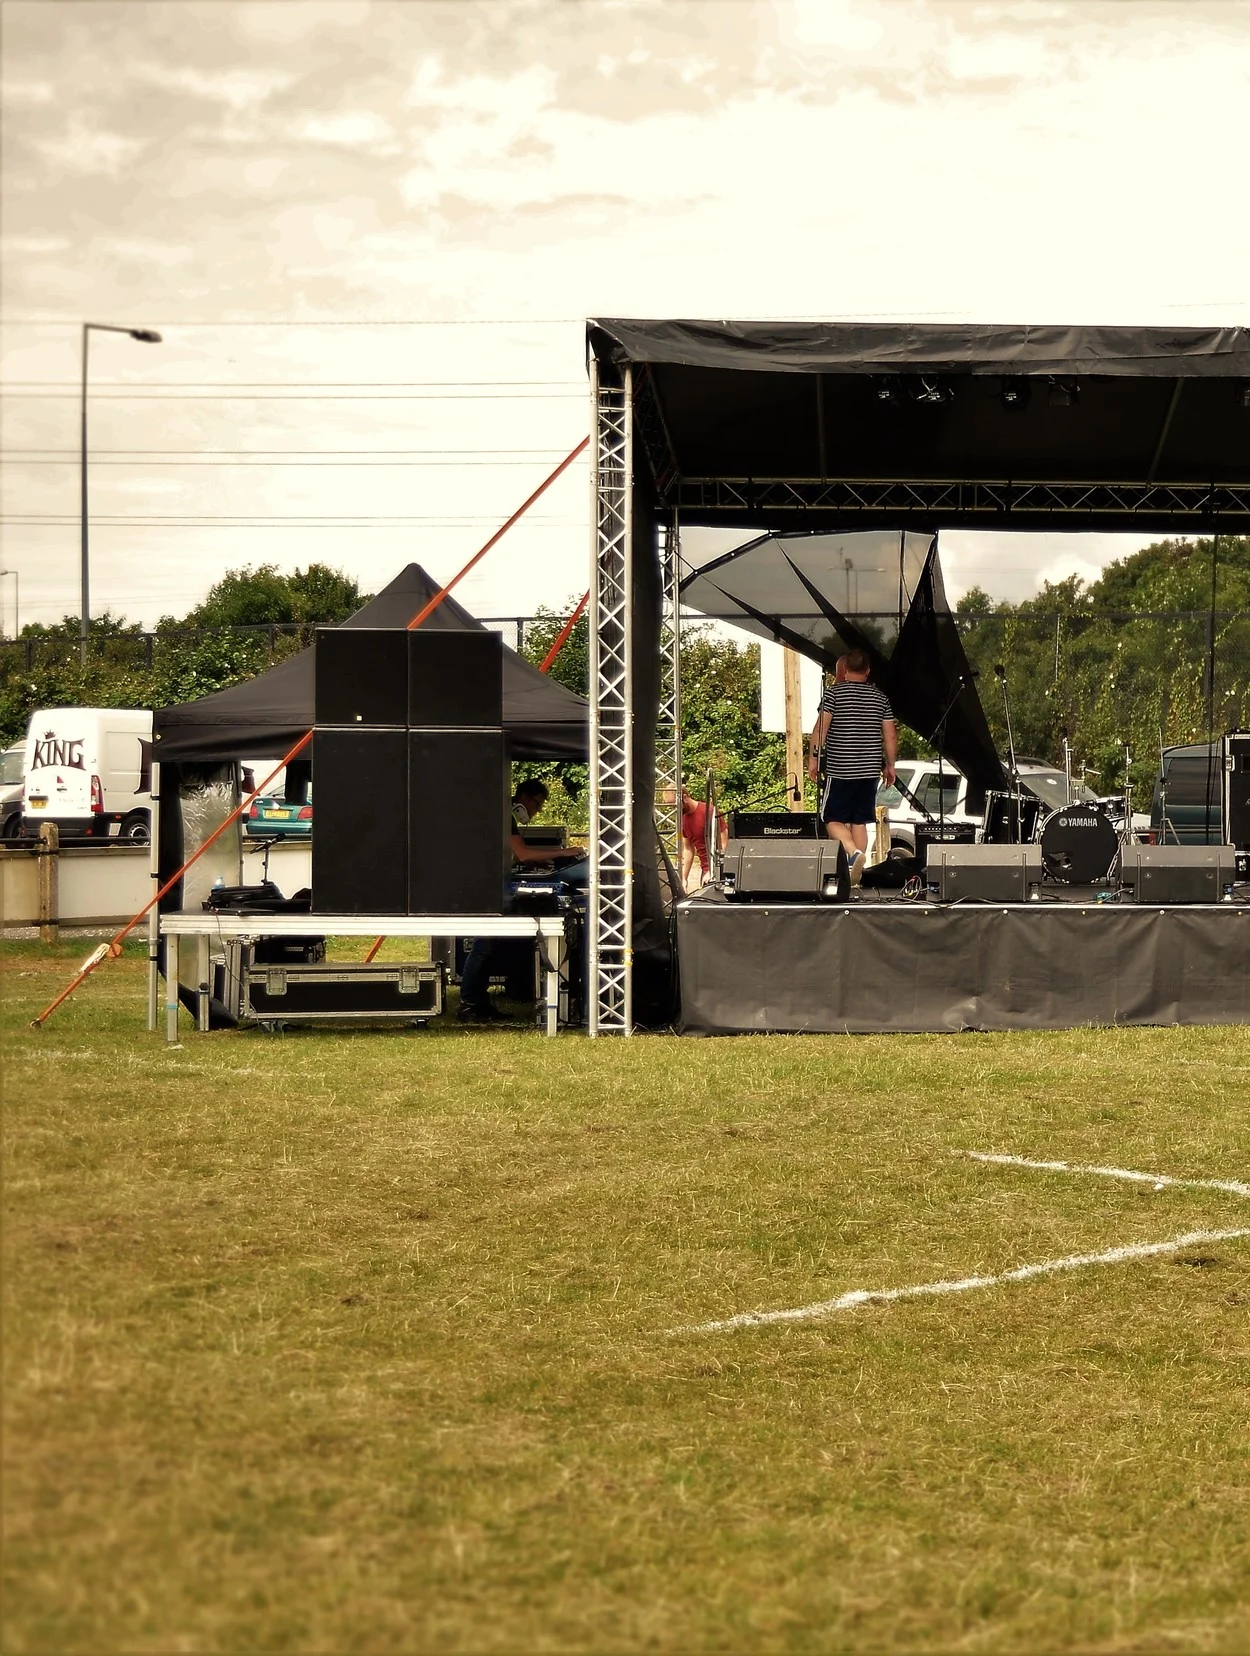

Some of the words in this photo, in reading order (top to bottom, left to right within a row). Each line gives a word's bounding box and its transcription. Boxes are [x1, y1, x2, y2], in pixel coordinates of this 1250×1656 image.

[31, 738, 86, 771] KING
[1068, 817, 1098, 827] YAMAHA
[763, 827, 801, 835] Blackstar
